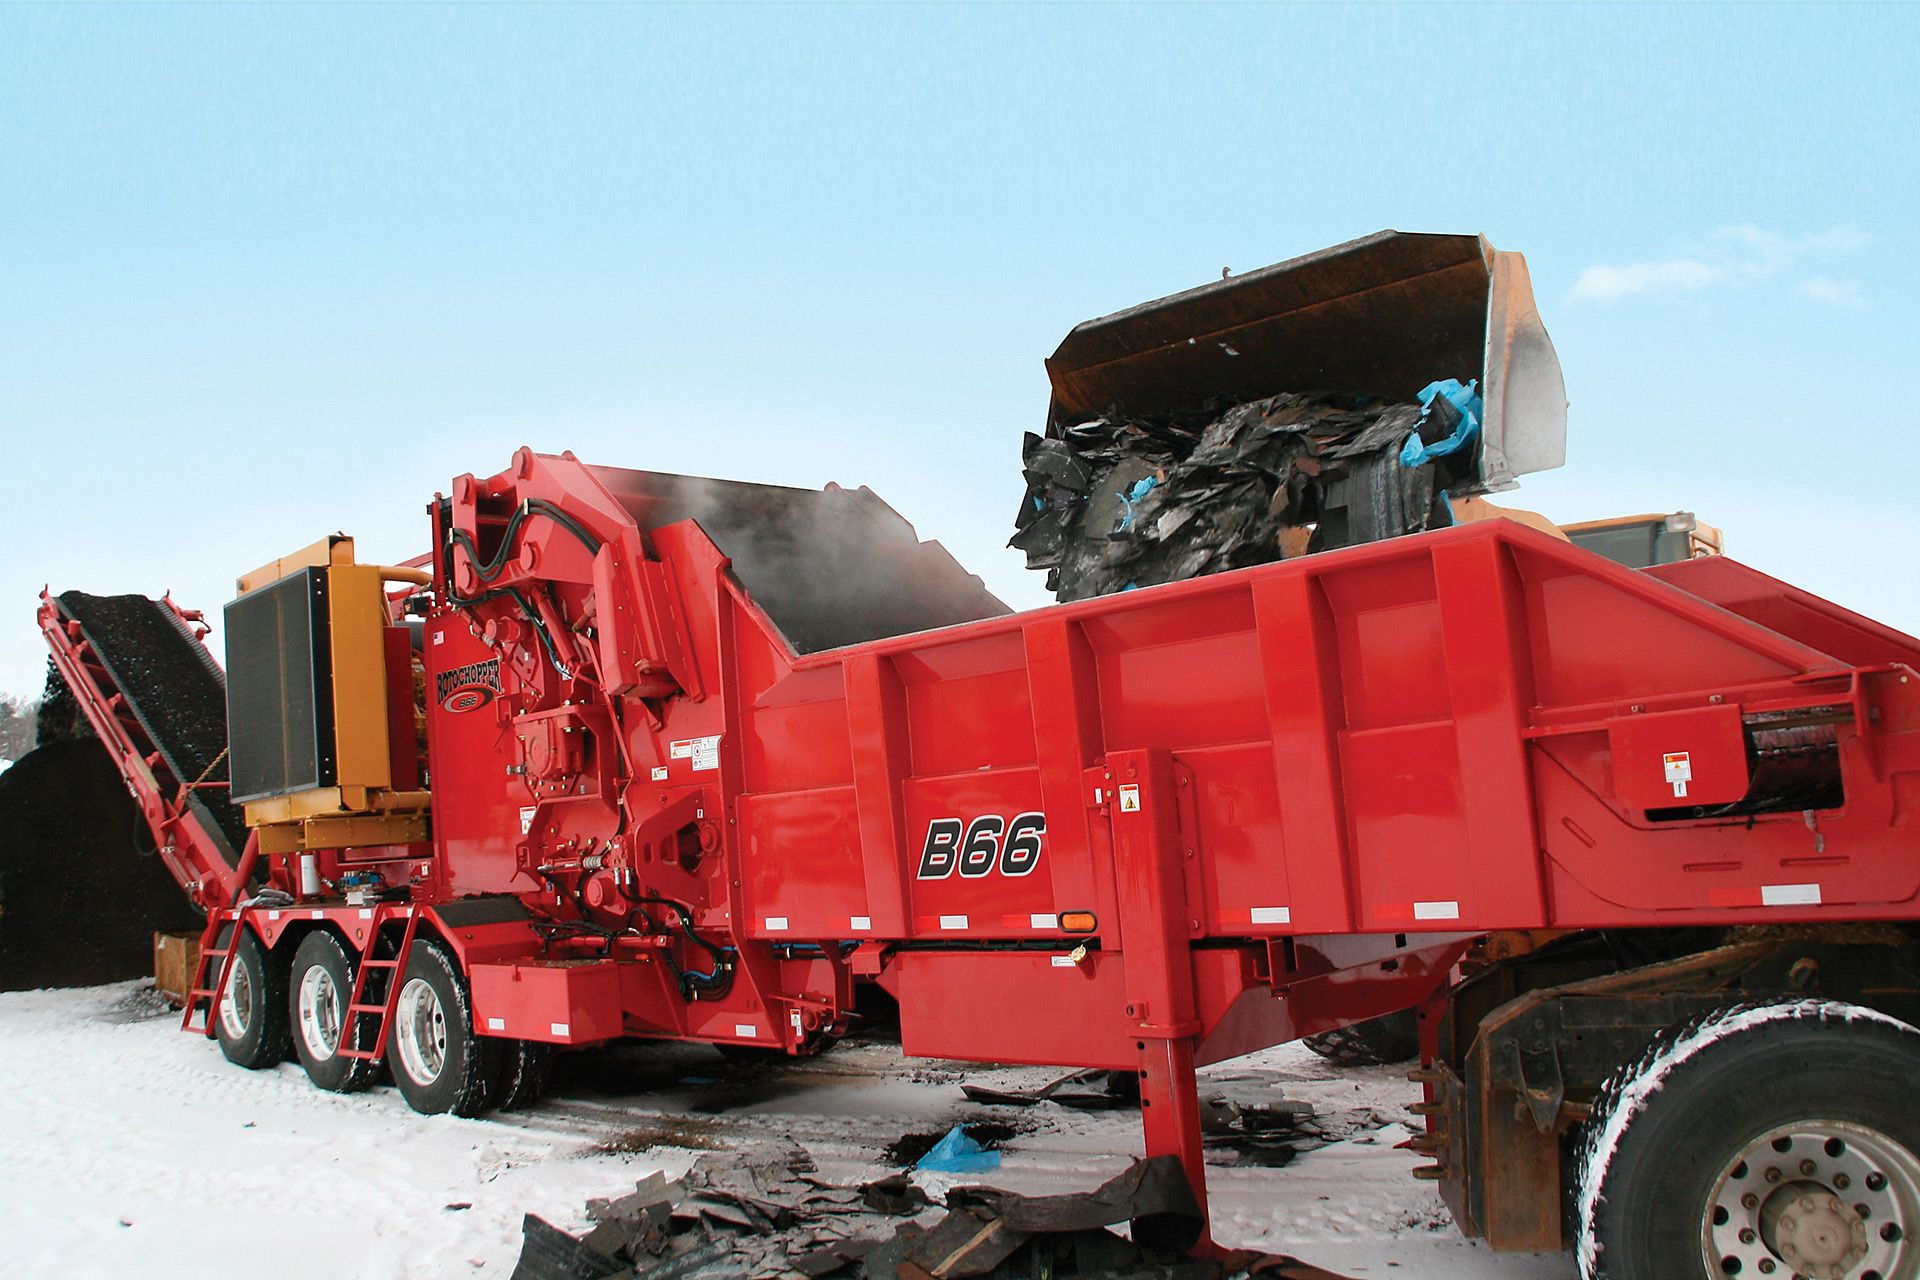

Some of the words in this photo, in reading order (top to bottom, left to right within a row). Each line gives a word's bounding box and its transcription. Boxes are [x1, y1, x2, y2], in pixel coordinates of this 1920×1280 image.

[437, 659, 502, 706] ROTOCHOPPER
[459, 696, 478, 708] B66
[917, 811, 1046, 880] B66
